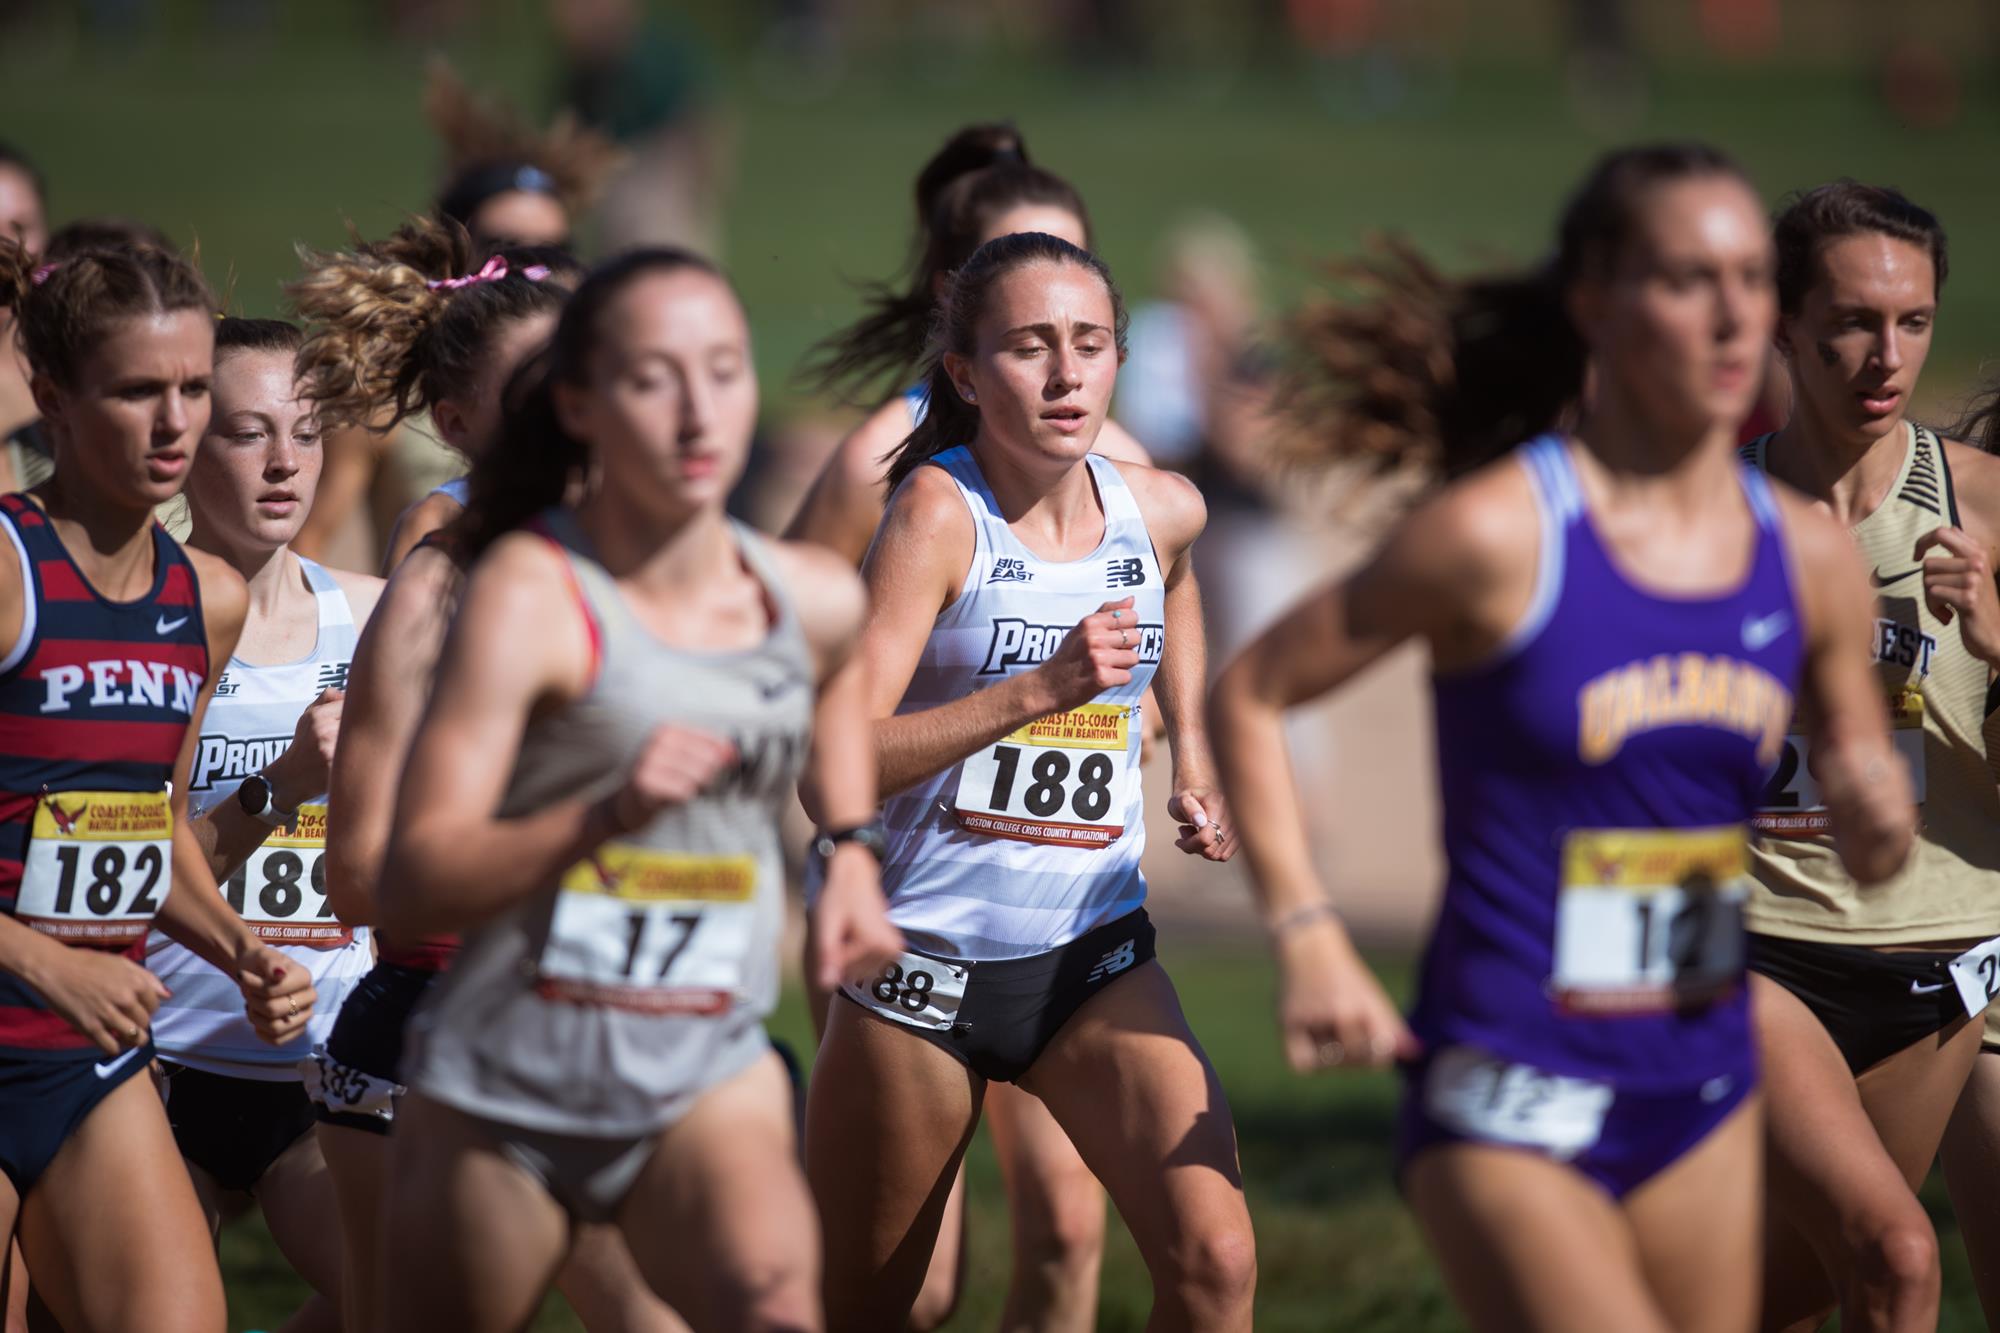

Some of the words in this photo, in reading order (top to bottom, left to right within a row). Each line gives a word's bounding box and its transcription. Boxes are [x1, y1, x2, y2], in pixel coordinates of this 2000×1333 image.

[990, 568, 1035, 582] EAST
[996, 557, 1025, 570] BIG
[977, 618, 1165, 676] PROCE
[1876, 617, 1937, 676] EST
[40, 659, 205, 715] PENN
[1030, 726, 1061, 737] BATTLE
[1063, 727, 1074, 738] IN
[1076, 728, 1118, 740] BEANTOWN
[988, 745, 1113, 821] 188
[965, 817, 992, 830] BOSTON
[993, 821, 1021, 834] COLLEGE
[1021, 824, 1042, 836] CROSS
[1043, 827, 1071, 839] COUNTRY
[53, 844, 163, 916] 182
[261, 927, 282, 937] CROSS
[283, 927, 310, 938] COUNTRY
[622, 913, 704, 978] 17
[863, 961, 934, 1012] 88
